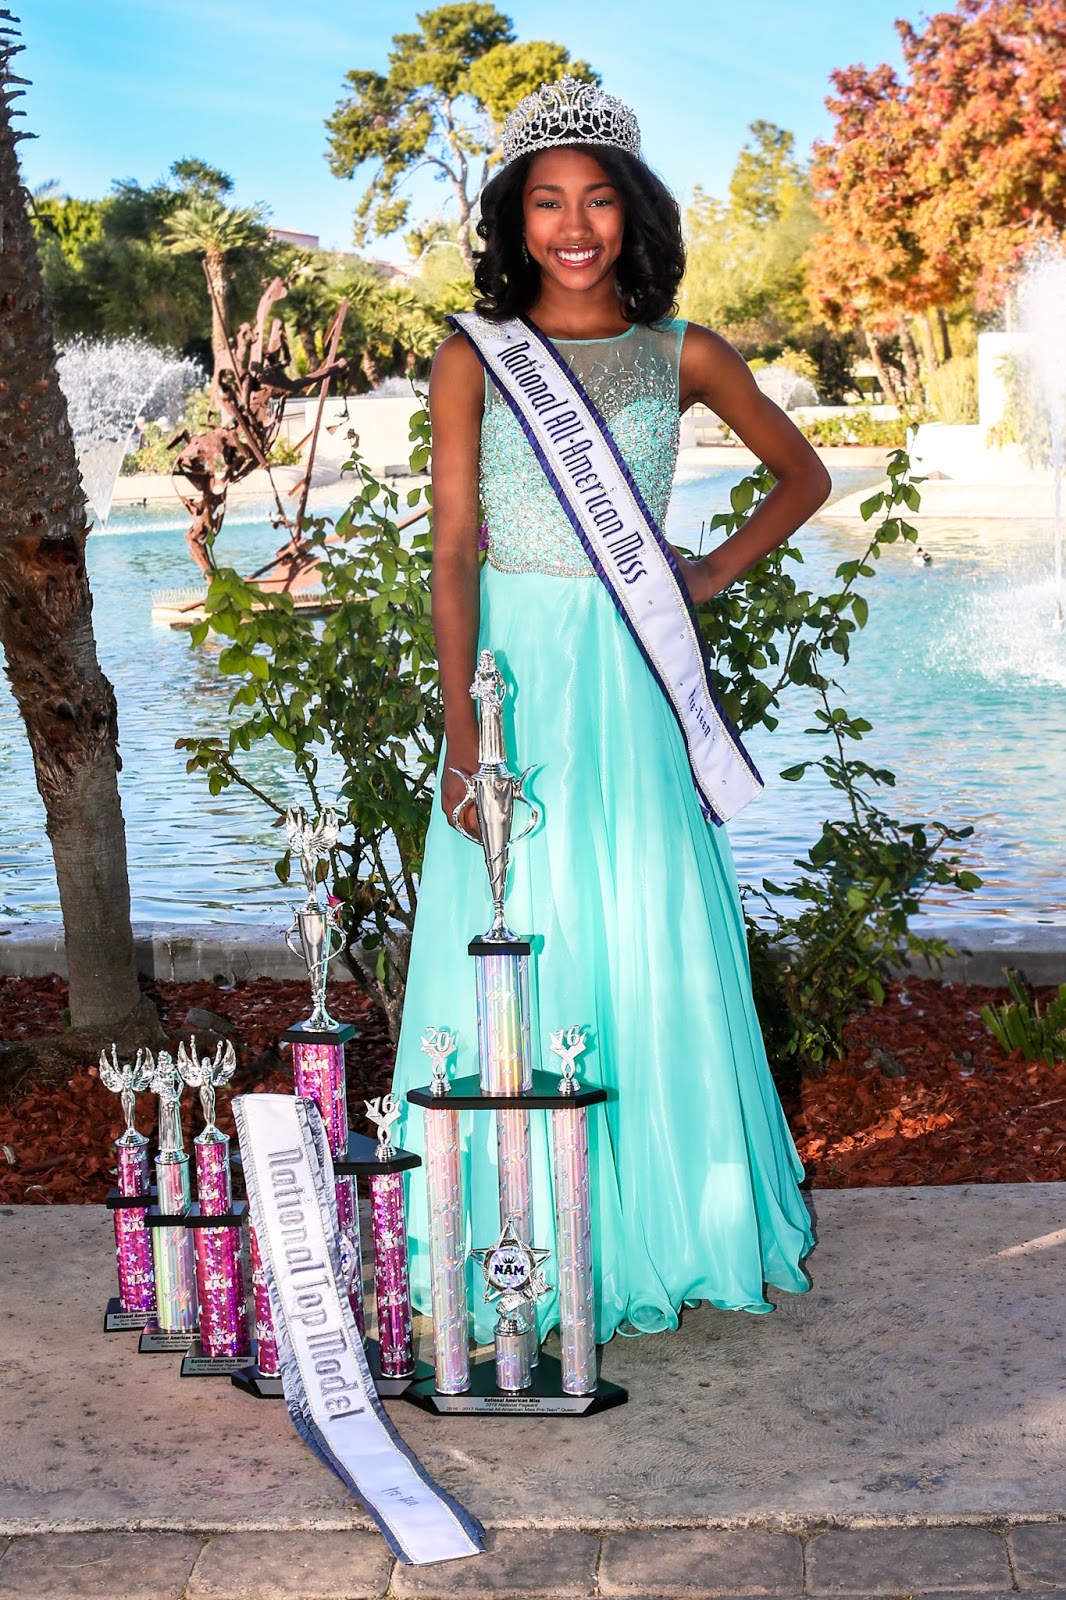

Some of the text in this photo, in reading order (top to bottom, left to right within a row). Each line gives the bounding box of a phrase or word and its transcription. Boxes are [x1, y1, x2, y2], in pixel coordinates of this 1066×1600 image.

[497, 340, 569, 416] National
[607, 531, 648, 585] Miss
[268, 1146, 366, 1423] National Top Model
[494, 1264, 525, 1275] NAM
